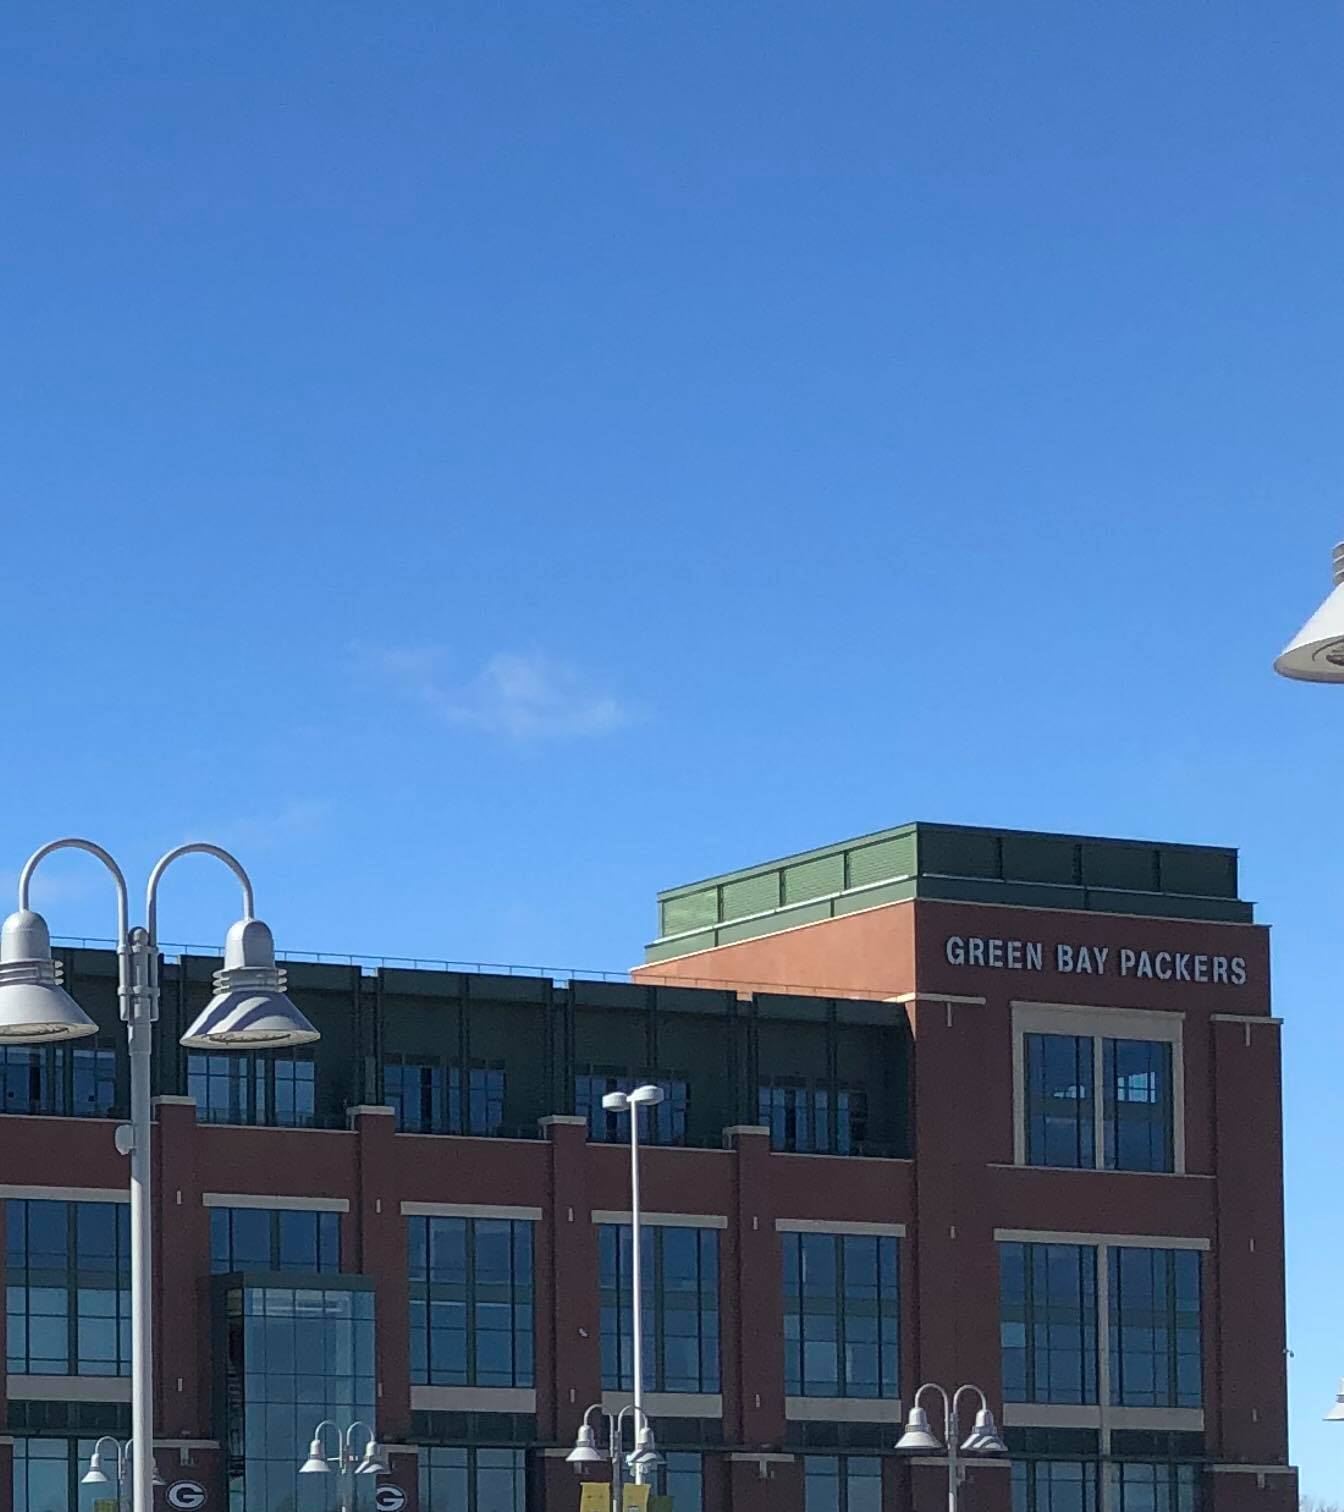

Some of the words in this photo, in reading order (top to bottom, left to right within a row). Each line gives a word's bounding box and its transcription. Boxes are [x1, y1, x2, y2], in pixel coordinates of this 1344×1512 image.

[946, 935, 1043, 971] GREEN
[1057, 944, 1109, 975] BAY
[1120, 949, 1247, 985] PACKERS
